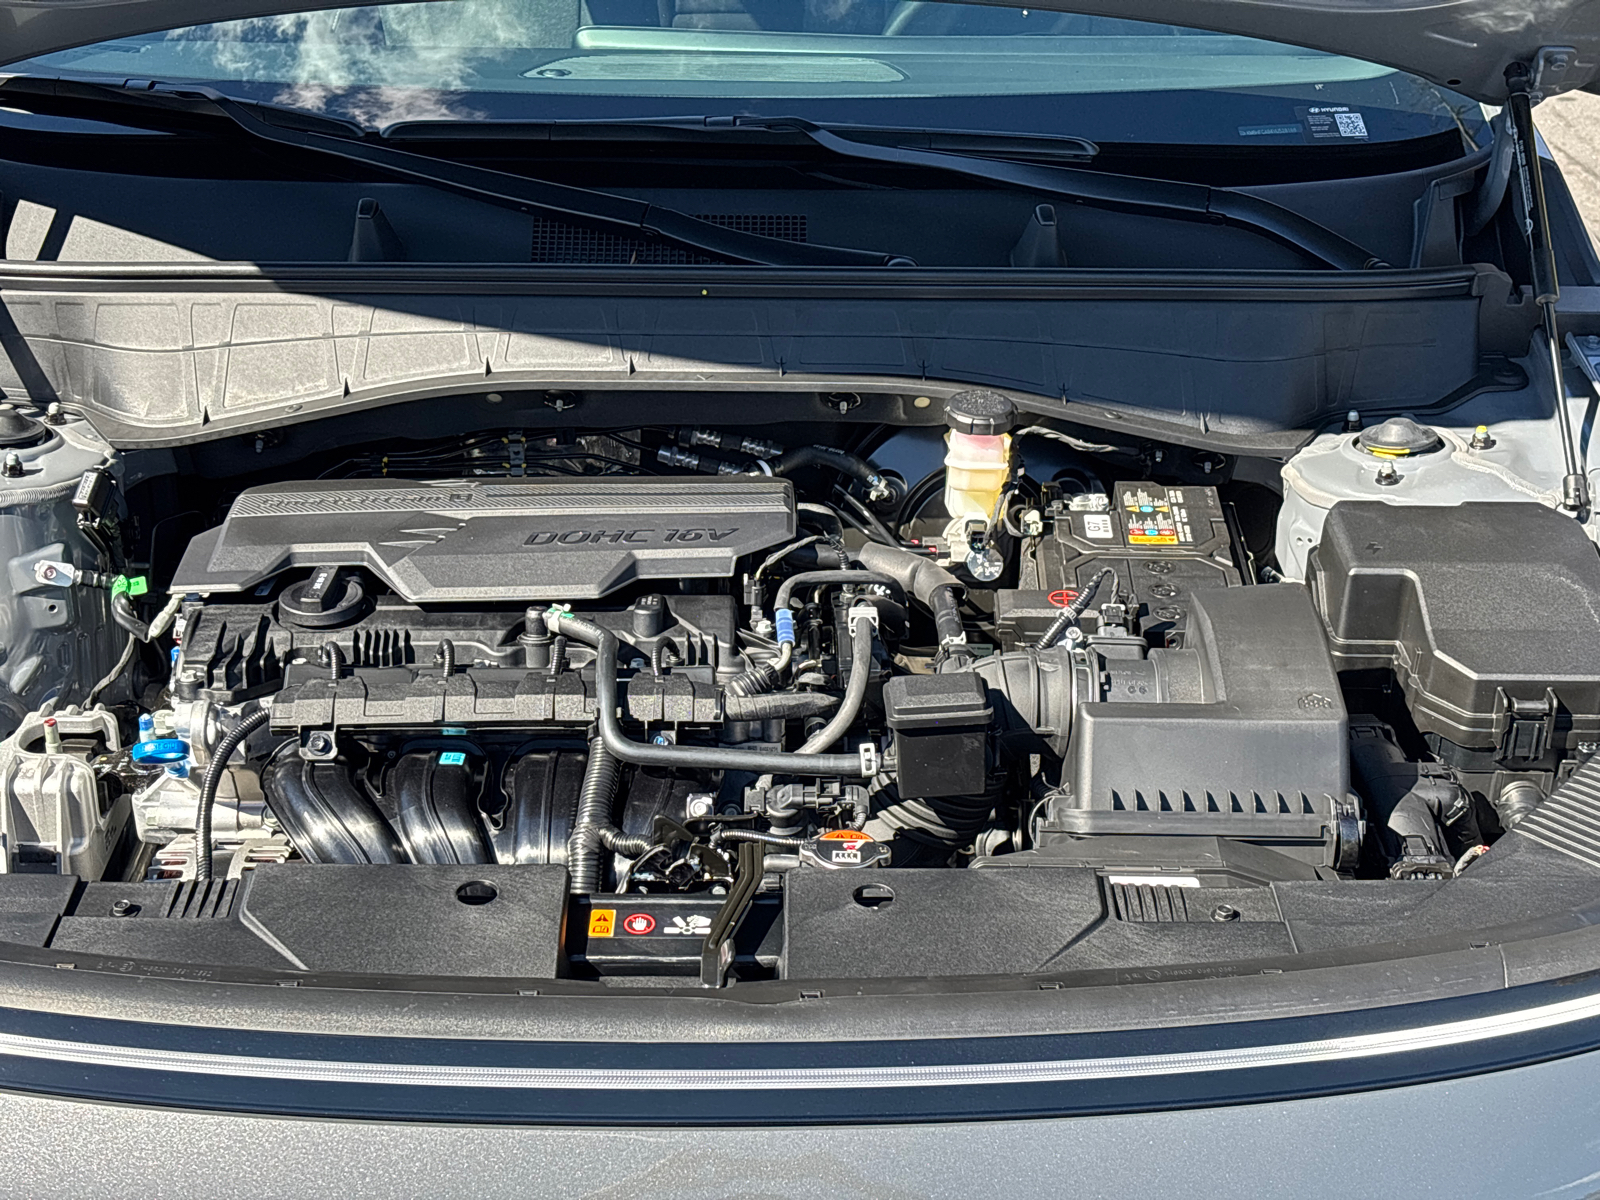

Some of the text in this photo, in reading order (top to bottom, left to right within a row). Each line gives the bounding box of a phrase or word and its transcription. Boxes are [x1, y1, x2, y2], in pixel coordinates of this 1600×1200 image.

[1087, 521, 1101, 532] G7
[522, 527, 740, 546] DOHC 16V
